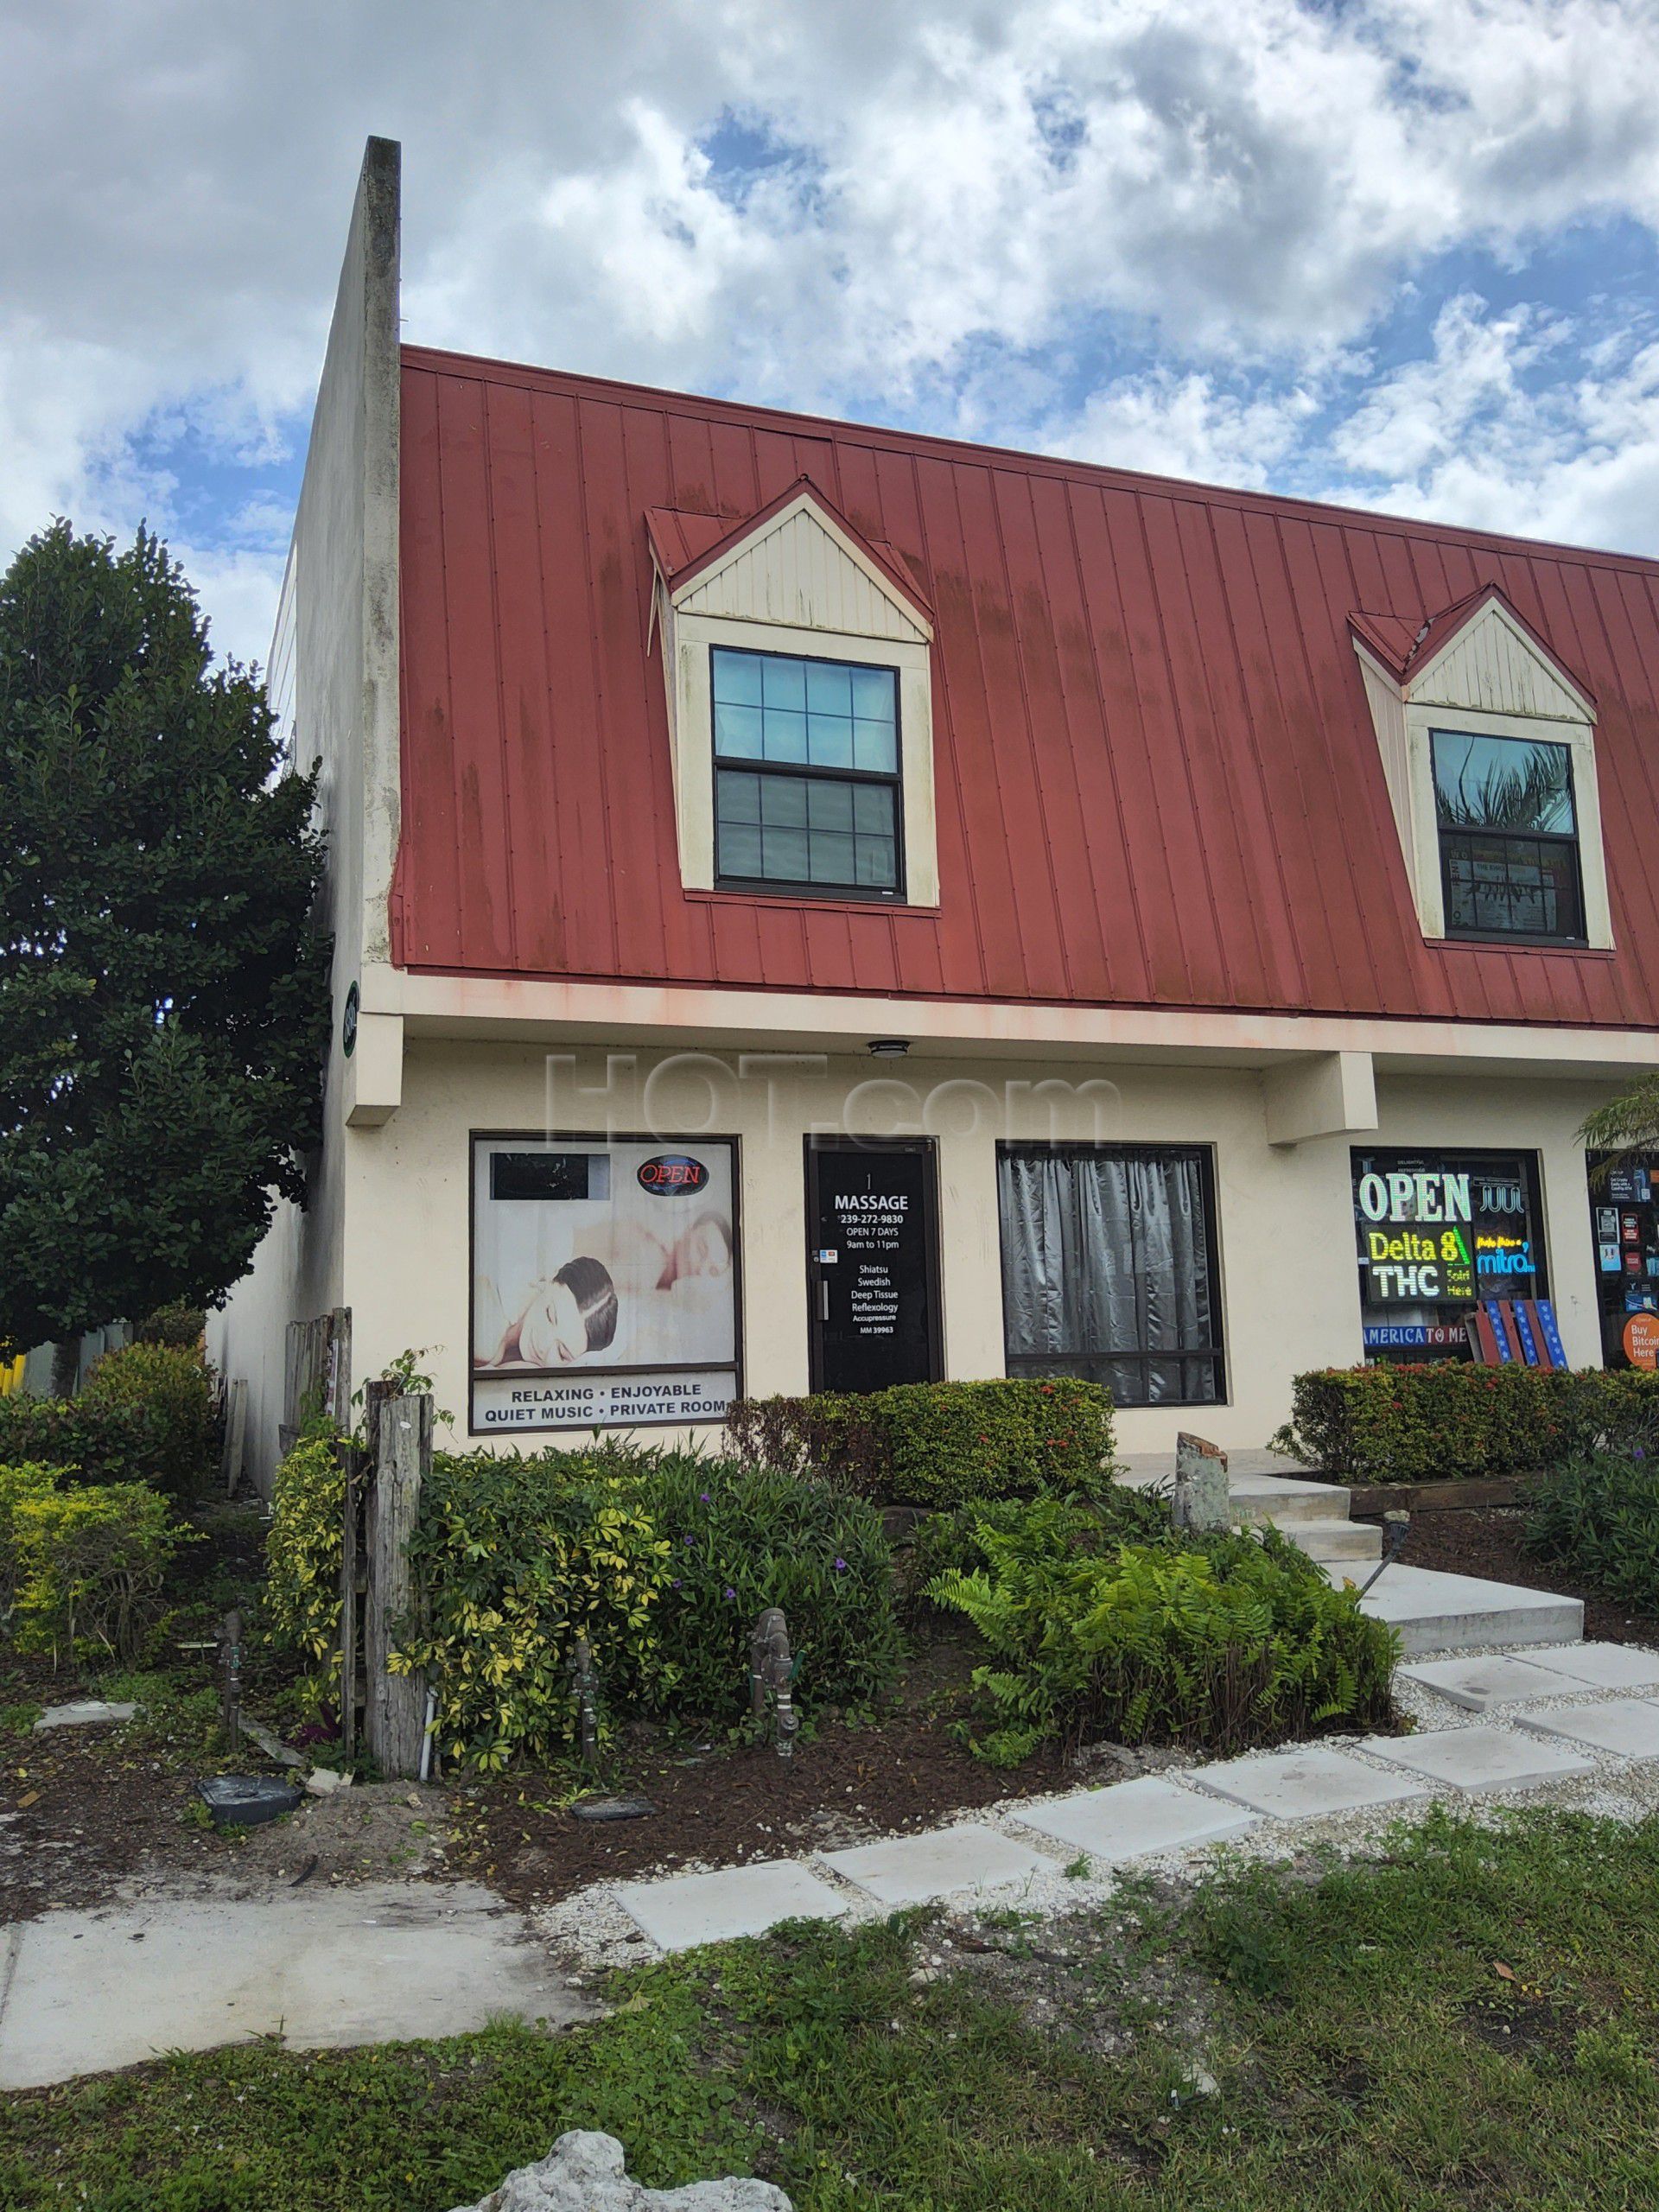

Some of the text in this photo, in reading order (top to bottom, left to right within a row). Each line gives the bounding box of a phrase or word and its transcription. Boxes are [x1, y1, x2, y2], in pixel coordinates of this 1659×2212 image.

[640, 1165, 699, 1184] OPEN
[867, 1173, 871, 1190] 1
[835, 1195, 909, 1210] MASSAGE
[1359, 1173, 1471, 1222] OPEN
[1479, 1185, 1525, 1214] JUUL
[841, 1215, 904, 1224] 239-272-9830
[847, 1240, 864, 1249] 9am
[877, 1240, 899, 1250] 11pm
[1369, 1231, 1458, 1262] Delta 8
[859, 1265, 888, 1274] Shiatsu
[858, 1277, 891, 1286] Swedish
[1372, 1265, 1440, 1297] THC
[851, 1290, 899, 1300] Deep Tissue
[852, 1302, 899, 1313] Reflexology
[1426, 1327, 1445, 1343] TO
[1630, 1325, 1648, 1336] Buy
[1633, 1349, 1654, 1357] Here
[512, 1384, 702, 1403] RELAXING ENJOYABLE
[485, 1408, 536, 1422] QUIET
[541, 1406, 594, 1420] MUSIC
[610, 1402, 676, 1416] PRIVATE
